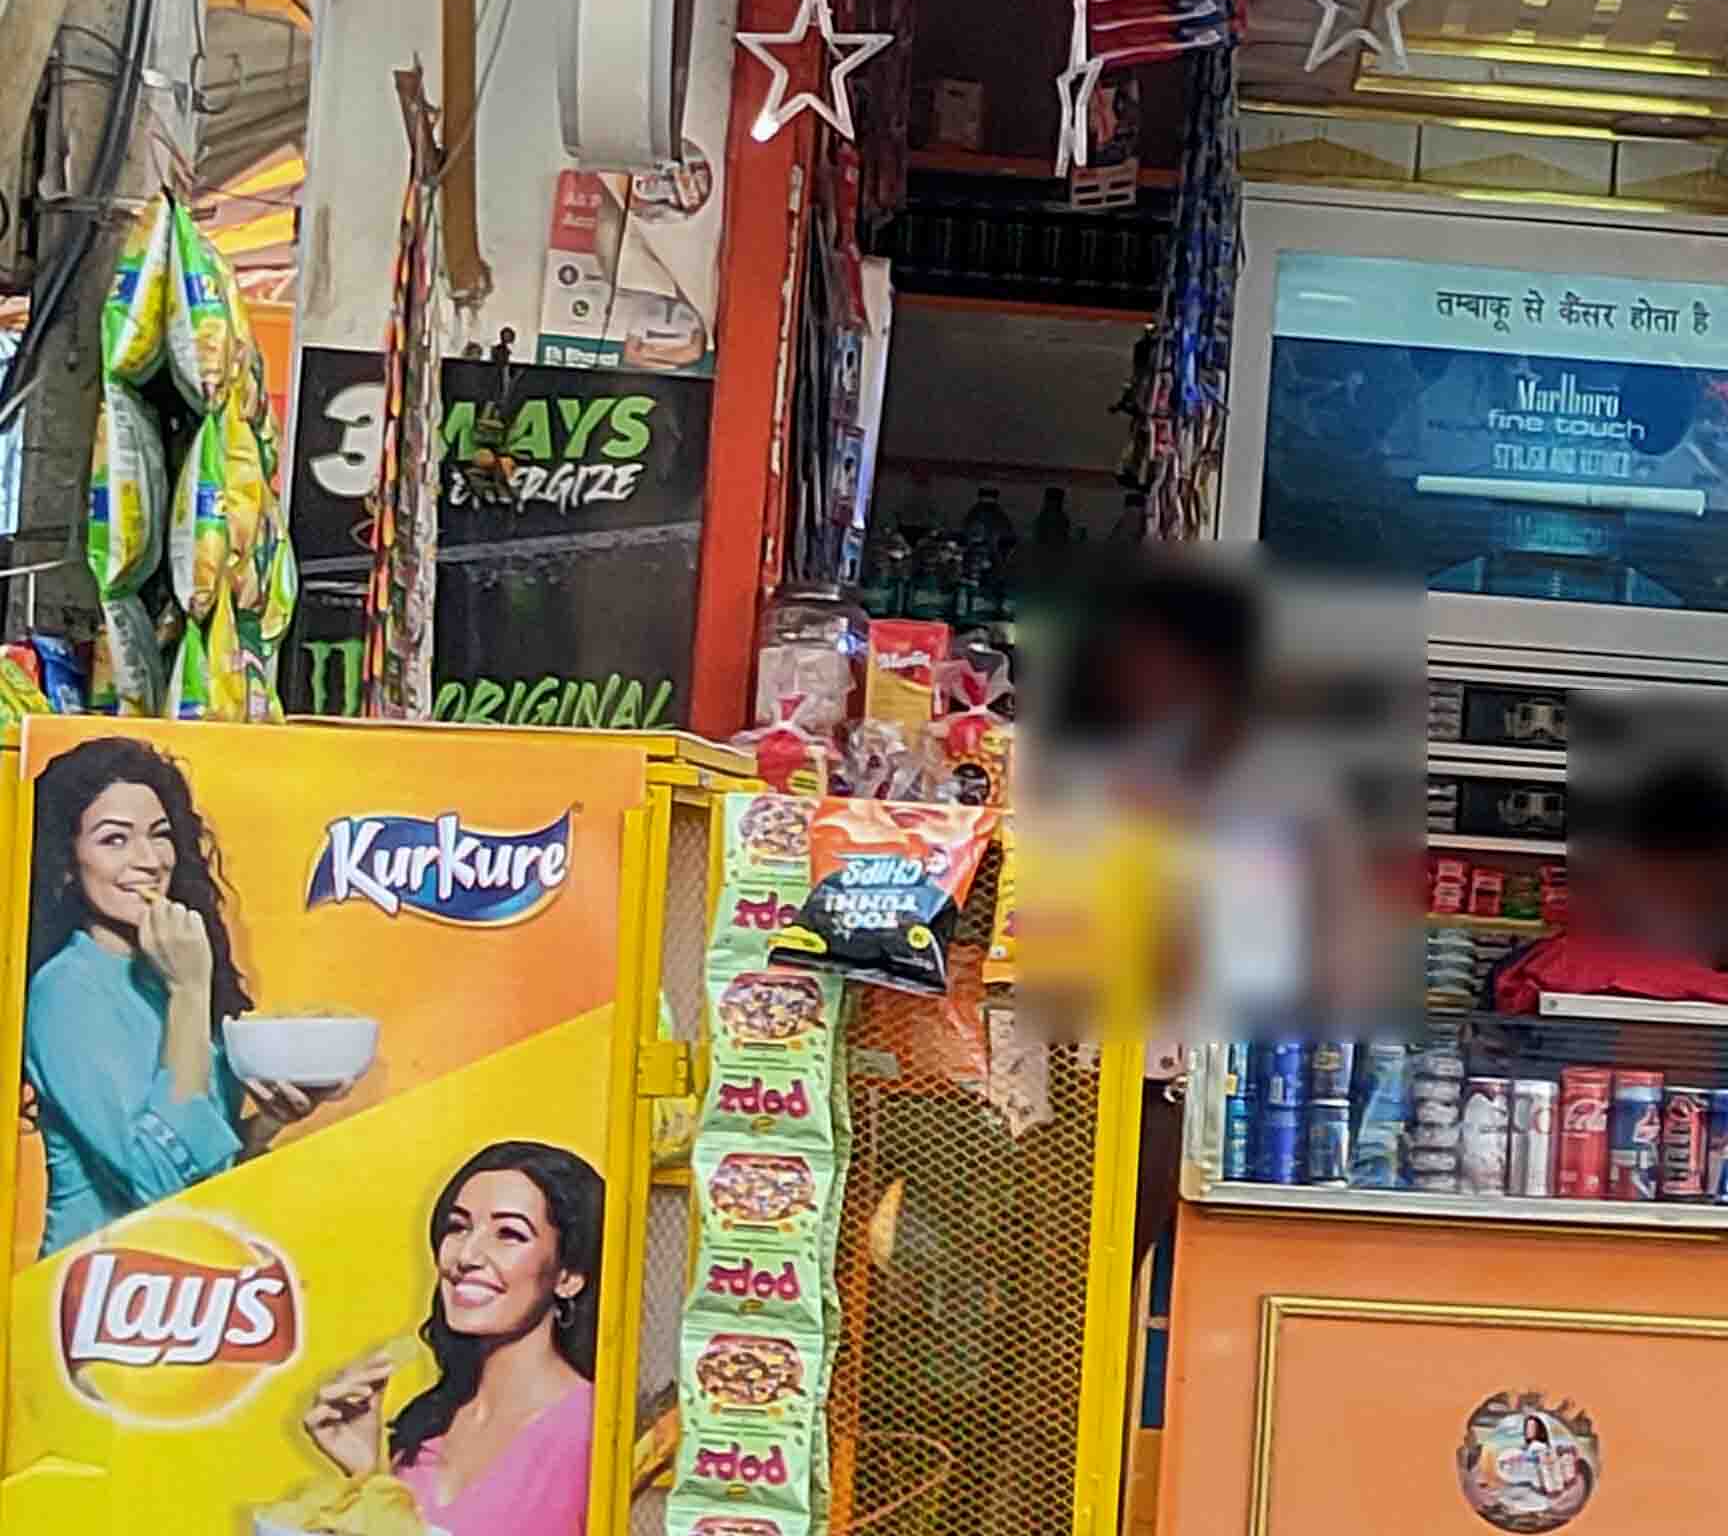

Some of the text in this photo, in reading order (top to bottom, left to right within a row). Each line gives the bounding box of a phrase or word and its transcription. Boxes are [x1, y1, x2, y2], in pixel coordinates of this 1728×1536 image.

[1522, 288, 1545, 323] से
[1629, 297, 1681, 334] होता
[1693, 301, 1711, 336] है
[1518, 372, 1620, 418] Marlboro
[1488, 409, 1646, 441] fine touch
[328, 810, 571, 917] Kurkure
[68, 1248, 287, 1366] Lay's
